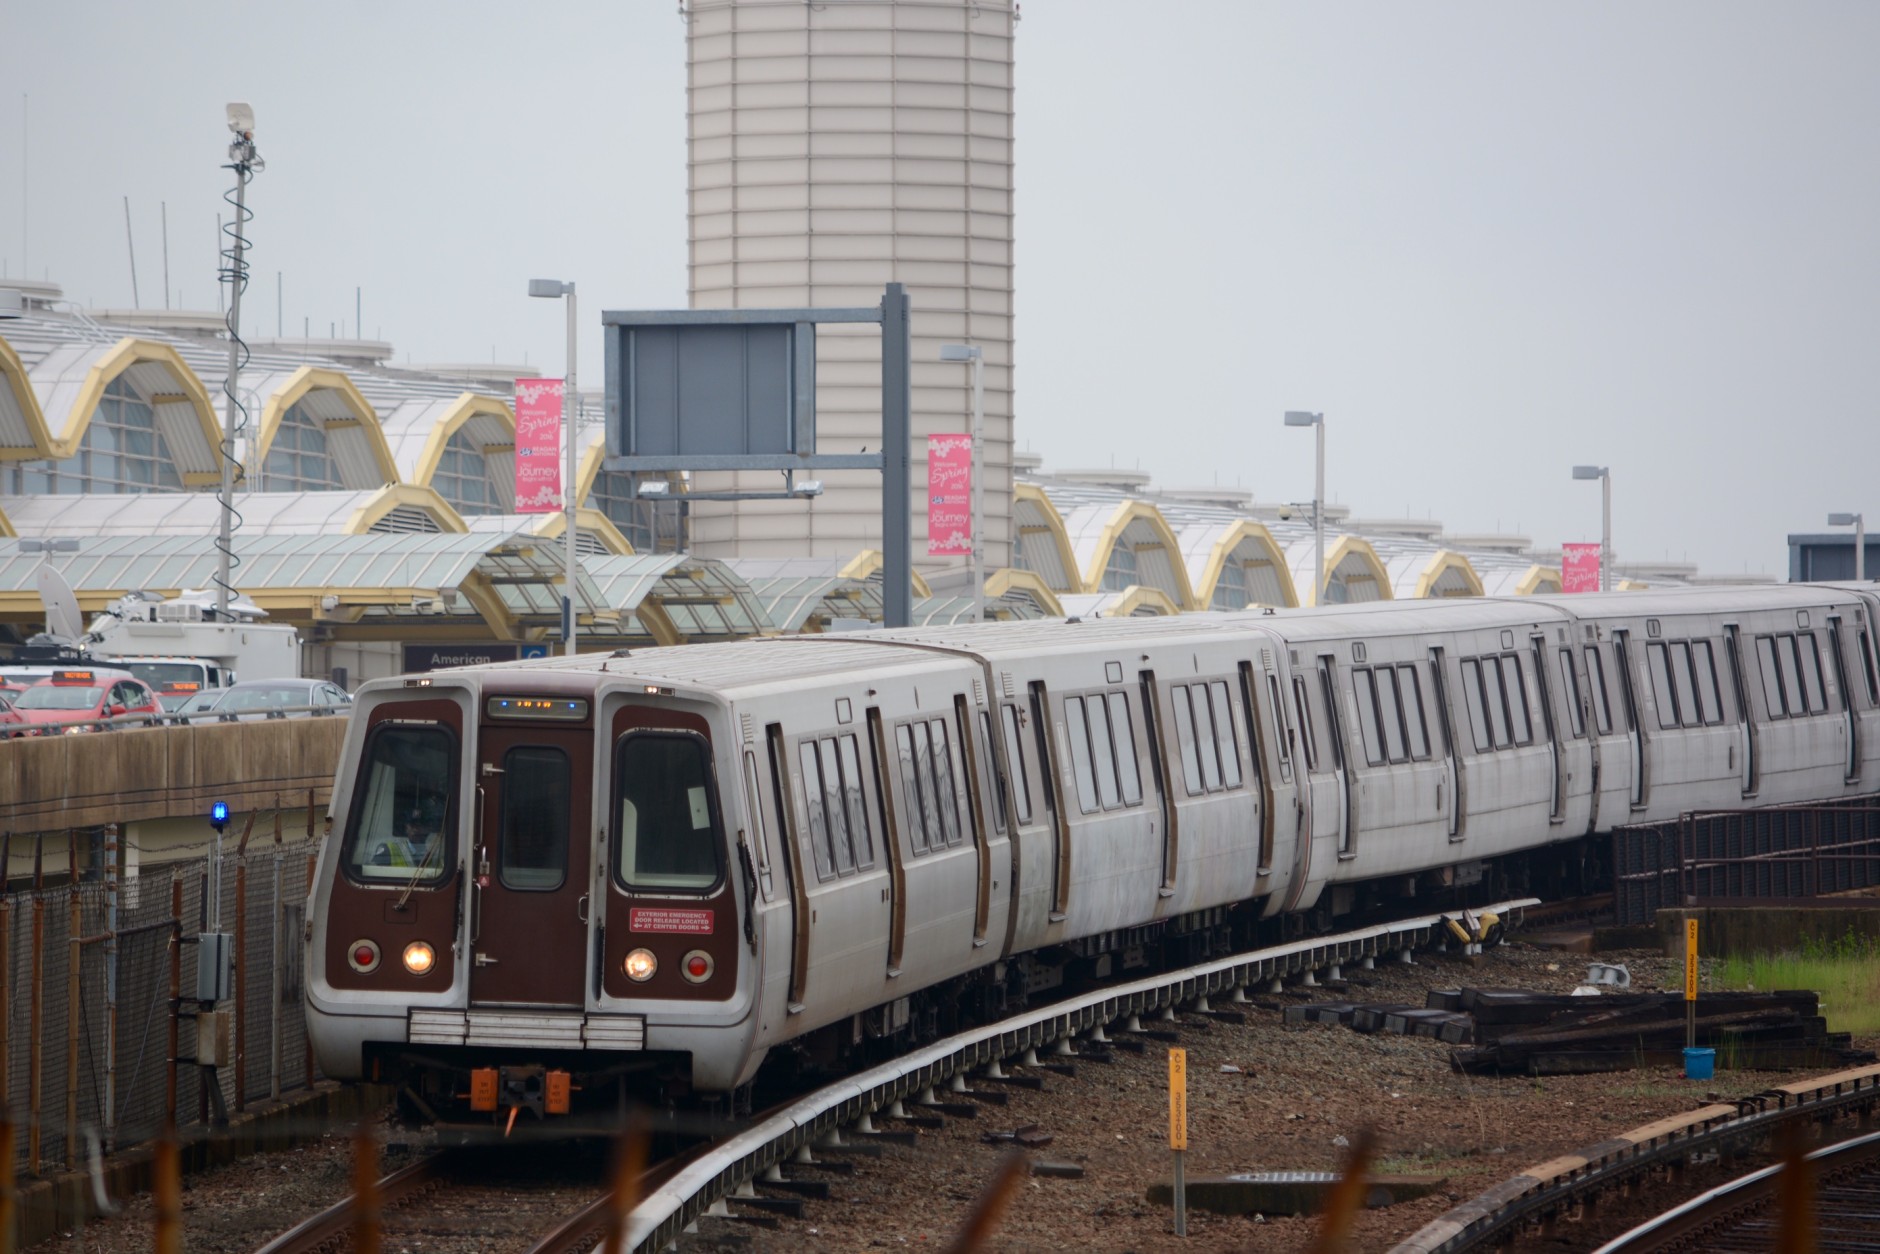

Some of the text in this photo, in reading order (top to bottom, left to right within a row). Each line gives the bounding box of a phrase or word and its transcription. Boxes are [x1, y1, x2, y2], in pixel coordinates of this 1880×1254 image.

[517, 415, 559, 438] Spring
[517, 466, 558, 479] Journey
[930, 466, 968, 488] Spring
[930, 512, 968, 524] Journey
[1564, 571, 1598, 590] Spring
[431, 653, 491, 665] American
